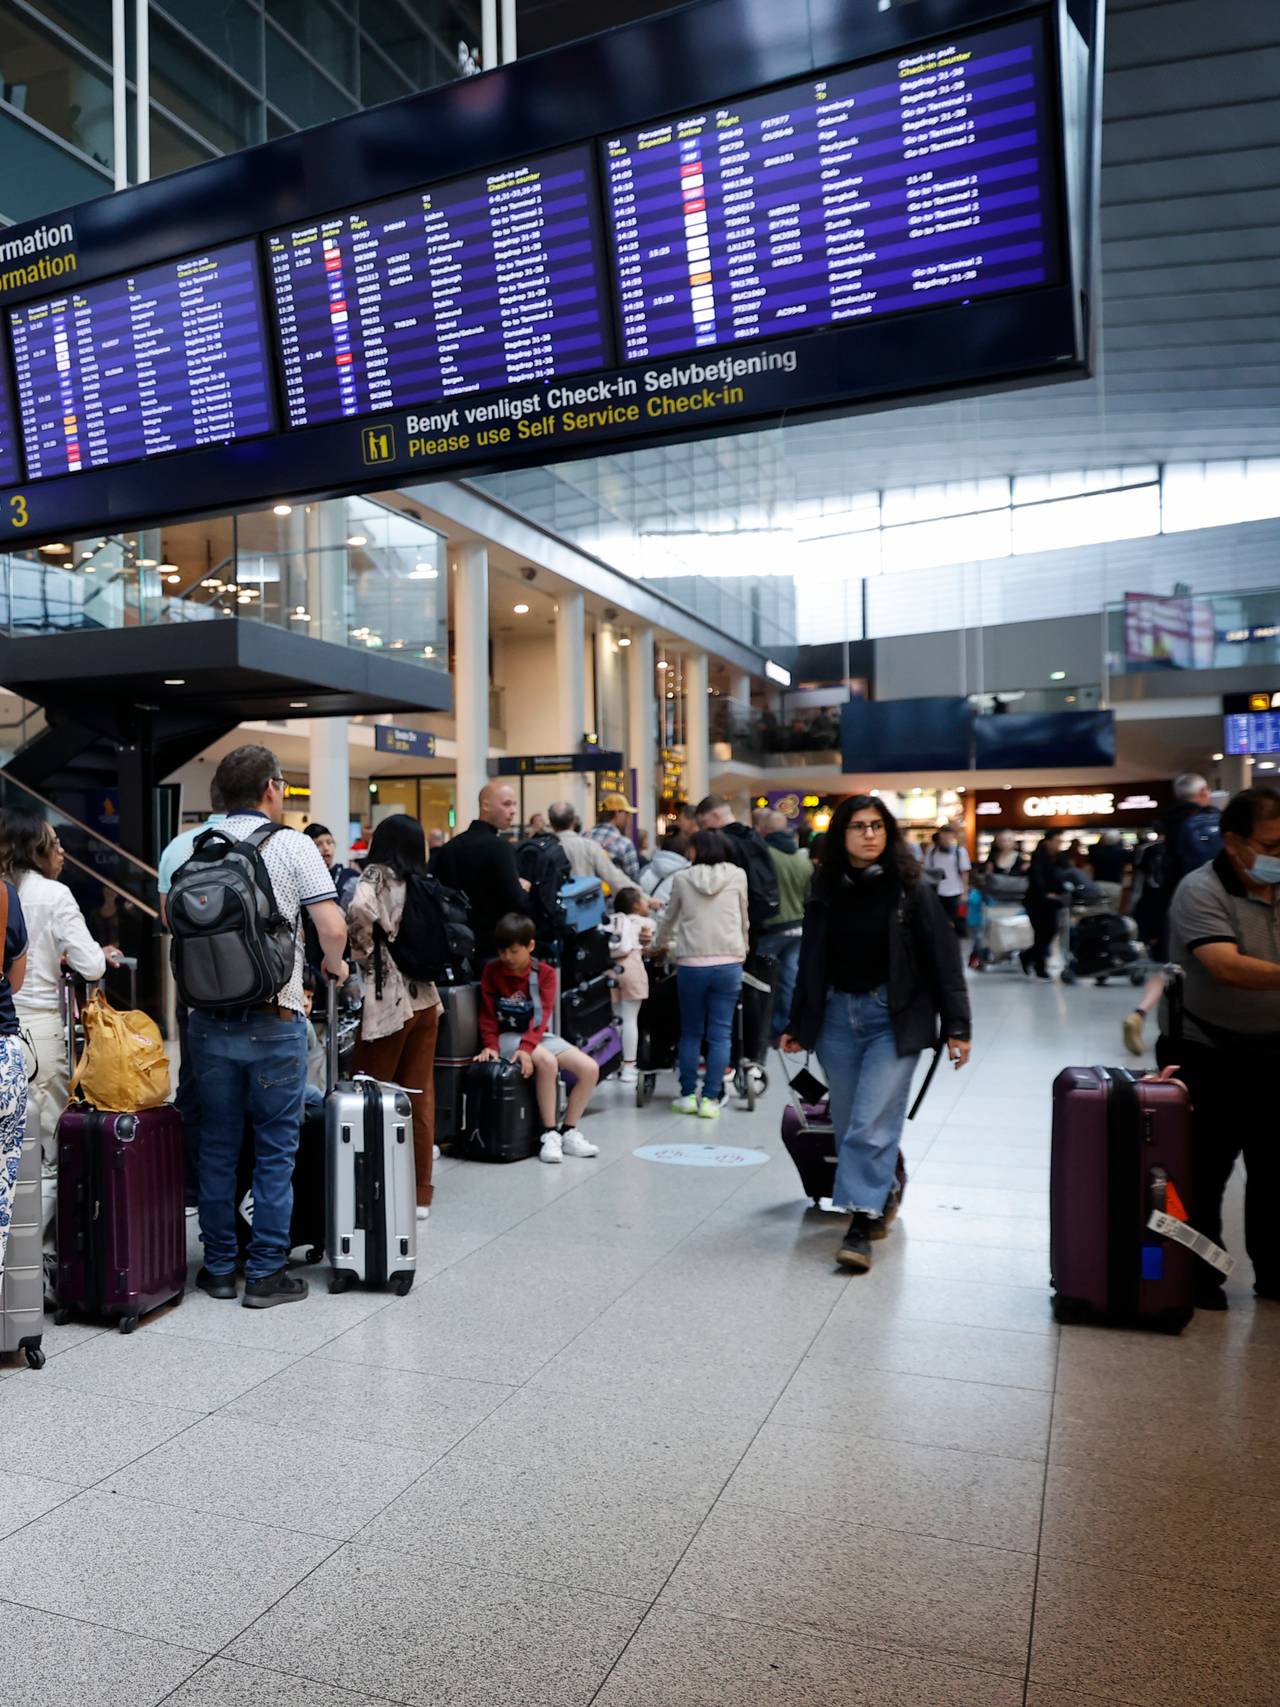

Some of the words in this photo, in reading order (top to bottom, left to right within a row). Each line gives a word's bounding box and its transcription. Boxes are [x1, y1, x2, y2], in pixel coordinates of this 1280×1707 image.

[899, 62, 936, 77] Check-in
[926, 95, 964, 111] Terminal
[716, 115, 739, 127] Flight
[928, 122, 966, 138] Terminal
[928, 135, 966, 151] Terminal
[609, 147, 626, 156] Time
[931, 176, 969, 192] Terminal
[932, 190, 970, 205] Terminal
[933, 203, 971, 218] Terminal
[934, 217, 972, 232] Terminal
[936, 257, 974, 271] Terminal
[406, 411, 460, 434] Benyt
[464, 394, 541, 424] venligst
[547, 377, 637, 409] Check-in
[644, 350, 798, 392] Selvbetjening
[408, 434, 470, 458] Please
[476, 427, 511, 446] use
[518, 415, 556, 439] Self
[562, 405, 640, 431] Service
[647, 385, 744, 417] Check-in
[10, 495, 29, 528] 3
